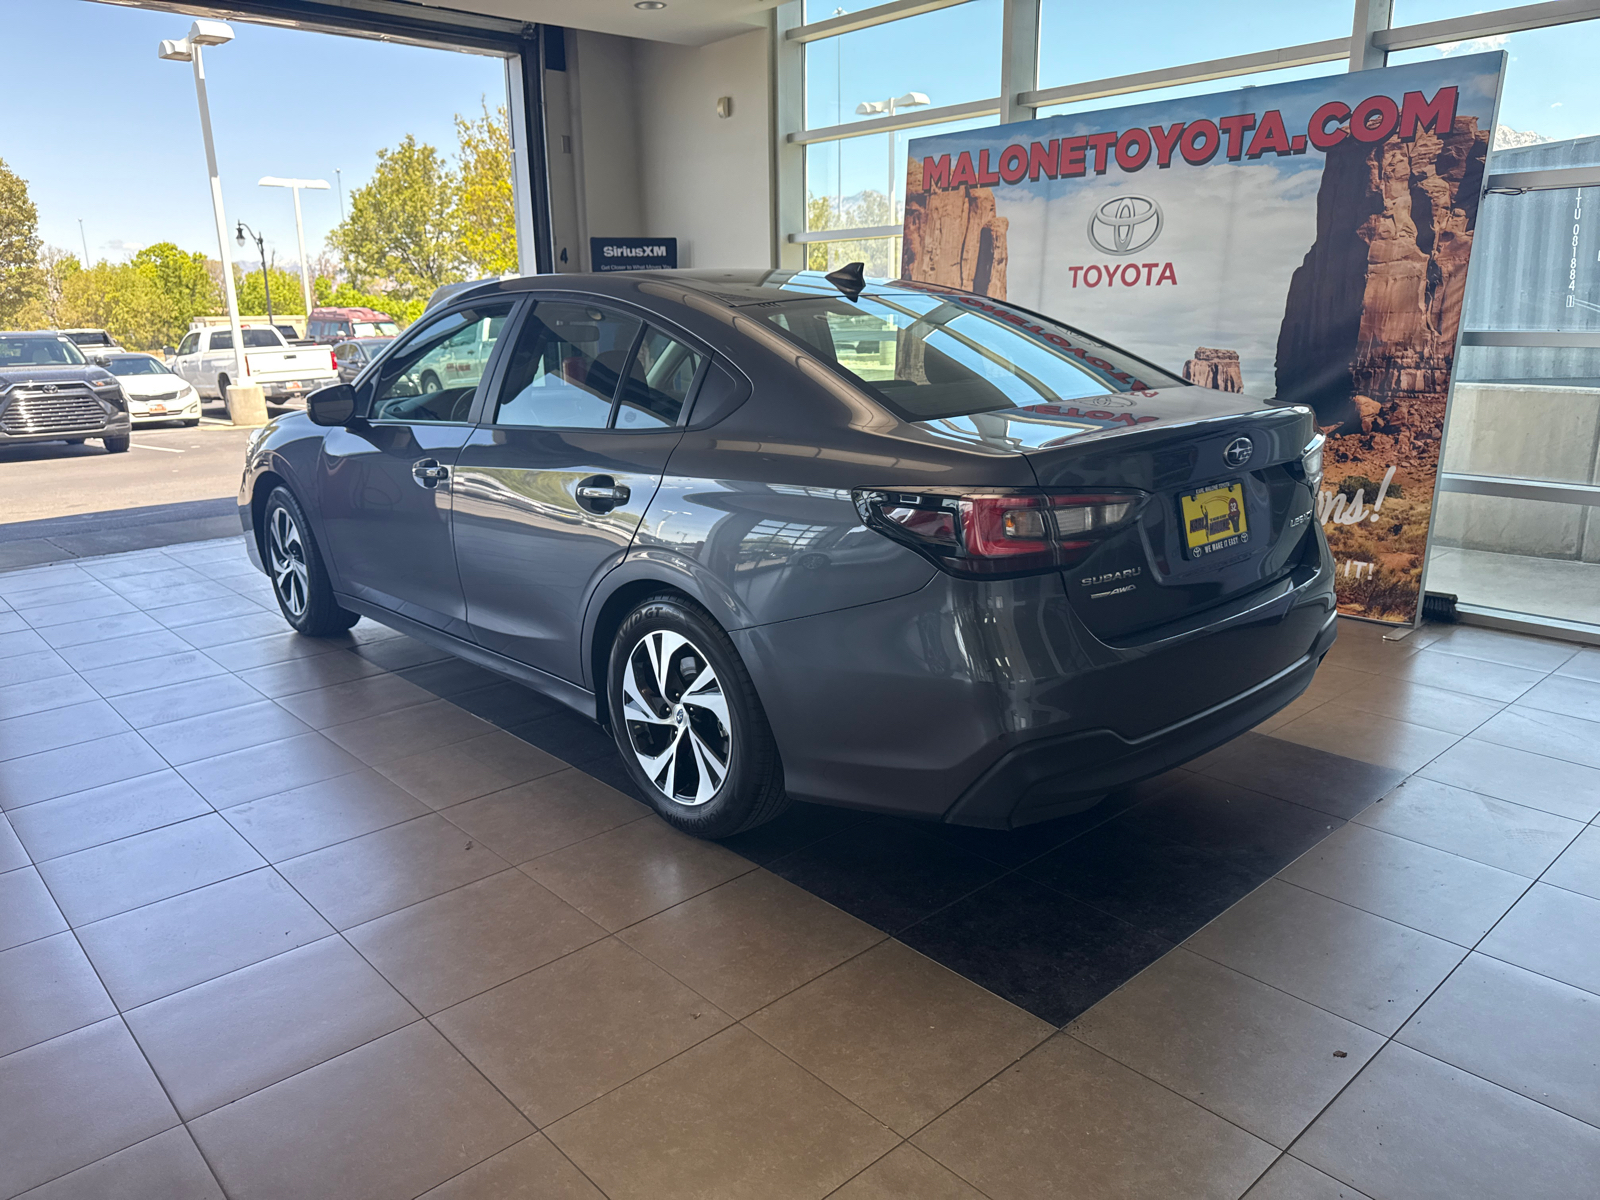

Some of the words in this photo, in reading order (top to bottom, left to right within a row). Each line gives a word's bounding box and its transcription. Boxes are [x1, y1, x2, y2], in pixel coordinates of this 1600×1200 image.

[922, 85, 1459, 193] MALONETOYOTA.COM
[560, 247, 568, 264] 4
[603, 246, 667, 257] SiriusXM
[1068, 262, 1178, 288] TOYOTA
[1230, 502, 1237, 512] 32
[1204, 544, 1212, 554] WE
[1081, 566, 1141, 587] SUBARU
[1344, 559, 1375, 580] IT!
[1110, 584, 1137, 596] AWD
[644, 606, 663, 619] GT
